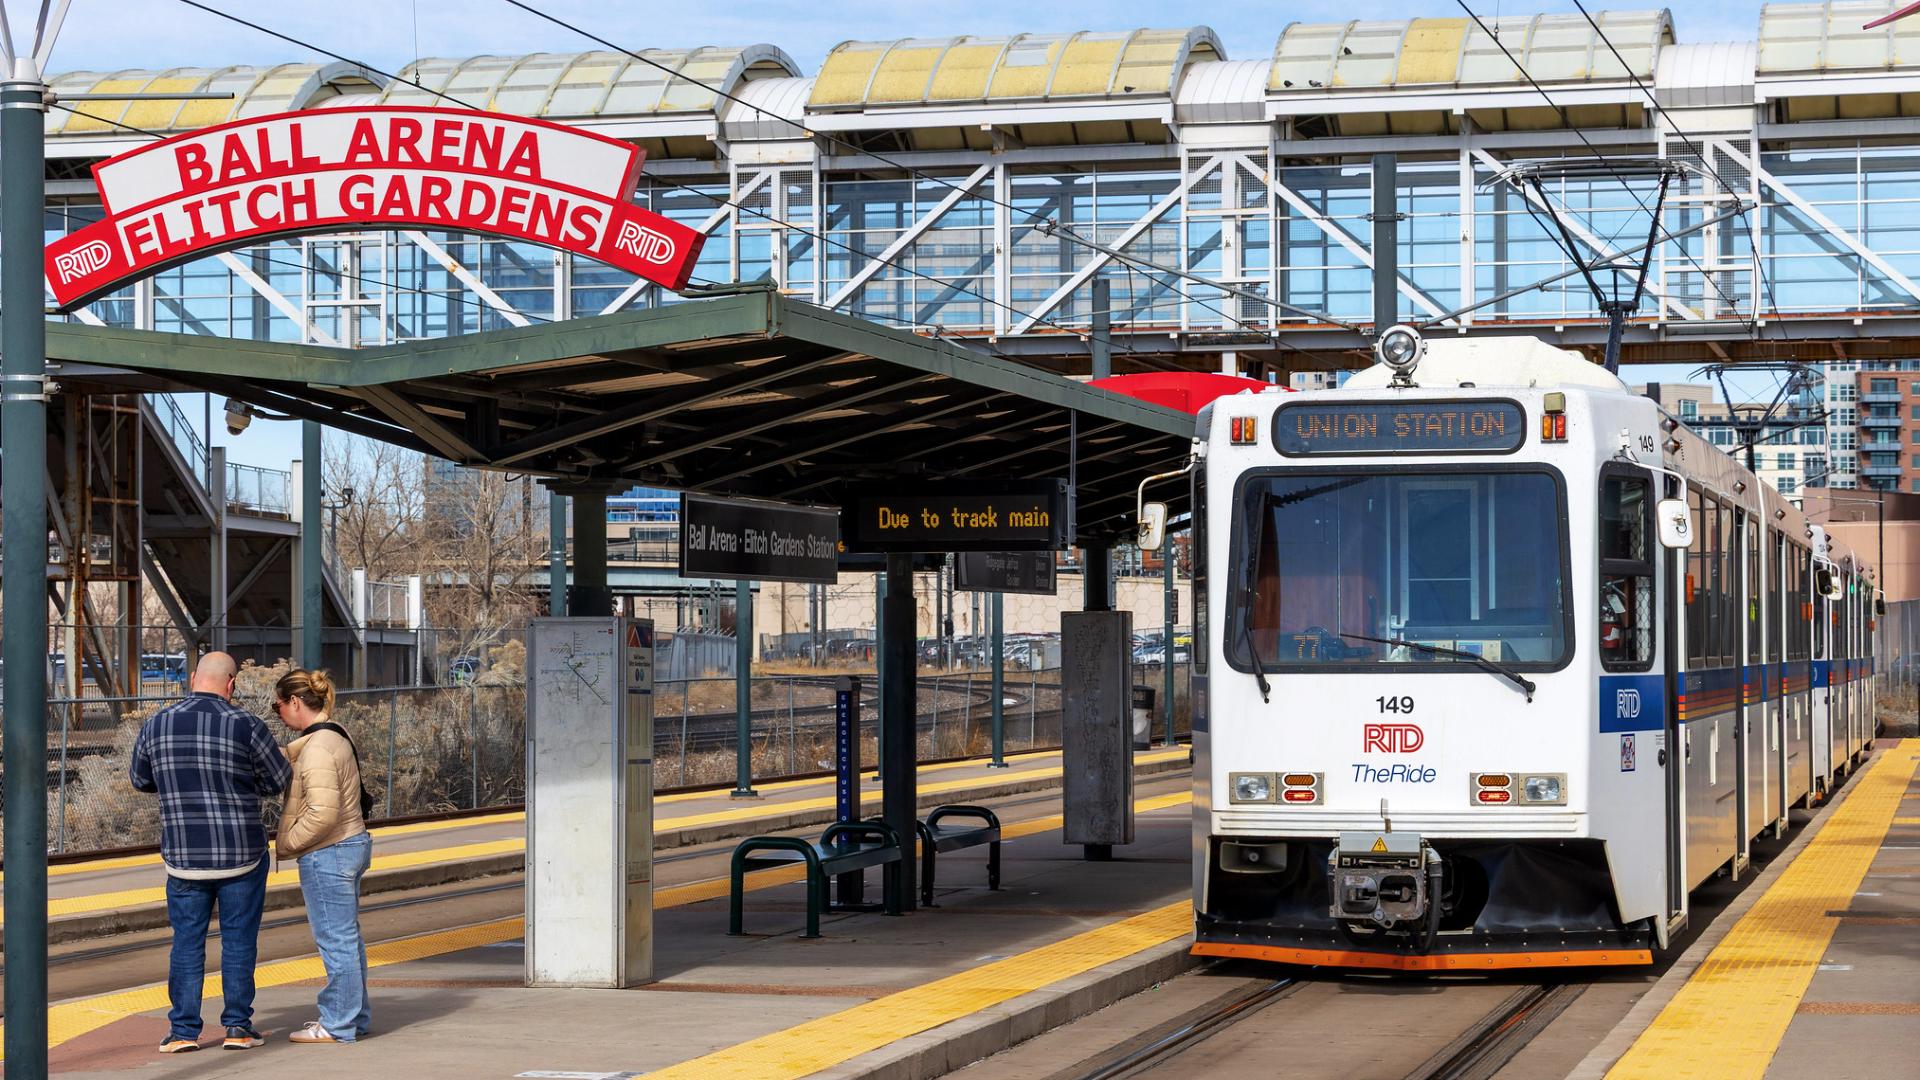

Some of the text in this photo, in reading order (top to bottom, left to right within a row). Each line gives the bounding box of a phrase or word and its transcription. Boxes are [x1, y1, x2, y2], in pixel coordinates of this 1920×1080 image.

[174, 117, 542, 191] BALL ARENA
[122, 174, 604, 263] ELITCH GARDENS
[614, 220, 676, 265] RTD
[54, 239, 112, 285] RTD
[1296, 410, 1506, 439] UNION STATION
[1638, 434, 1655, 453] 149
[878, 505, 1049, 529] Due to track main
[688, 523, 706, 550] Ball
[709, 525, 738, 552] Arena
[744, 528, 768, 555] Elitch
[770, 530, 805, 557] Gardens
[807, 533, 835, 559] Station
[1293, 634, 1320, 659] 77
[1375, 695, 1415, 715] 149
[1616, 688, 1641, 719] RTD
[1363, 723, 1424, 753] RTD
[1351, 763, 1437, 784] TheRide
